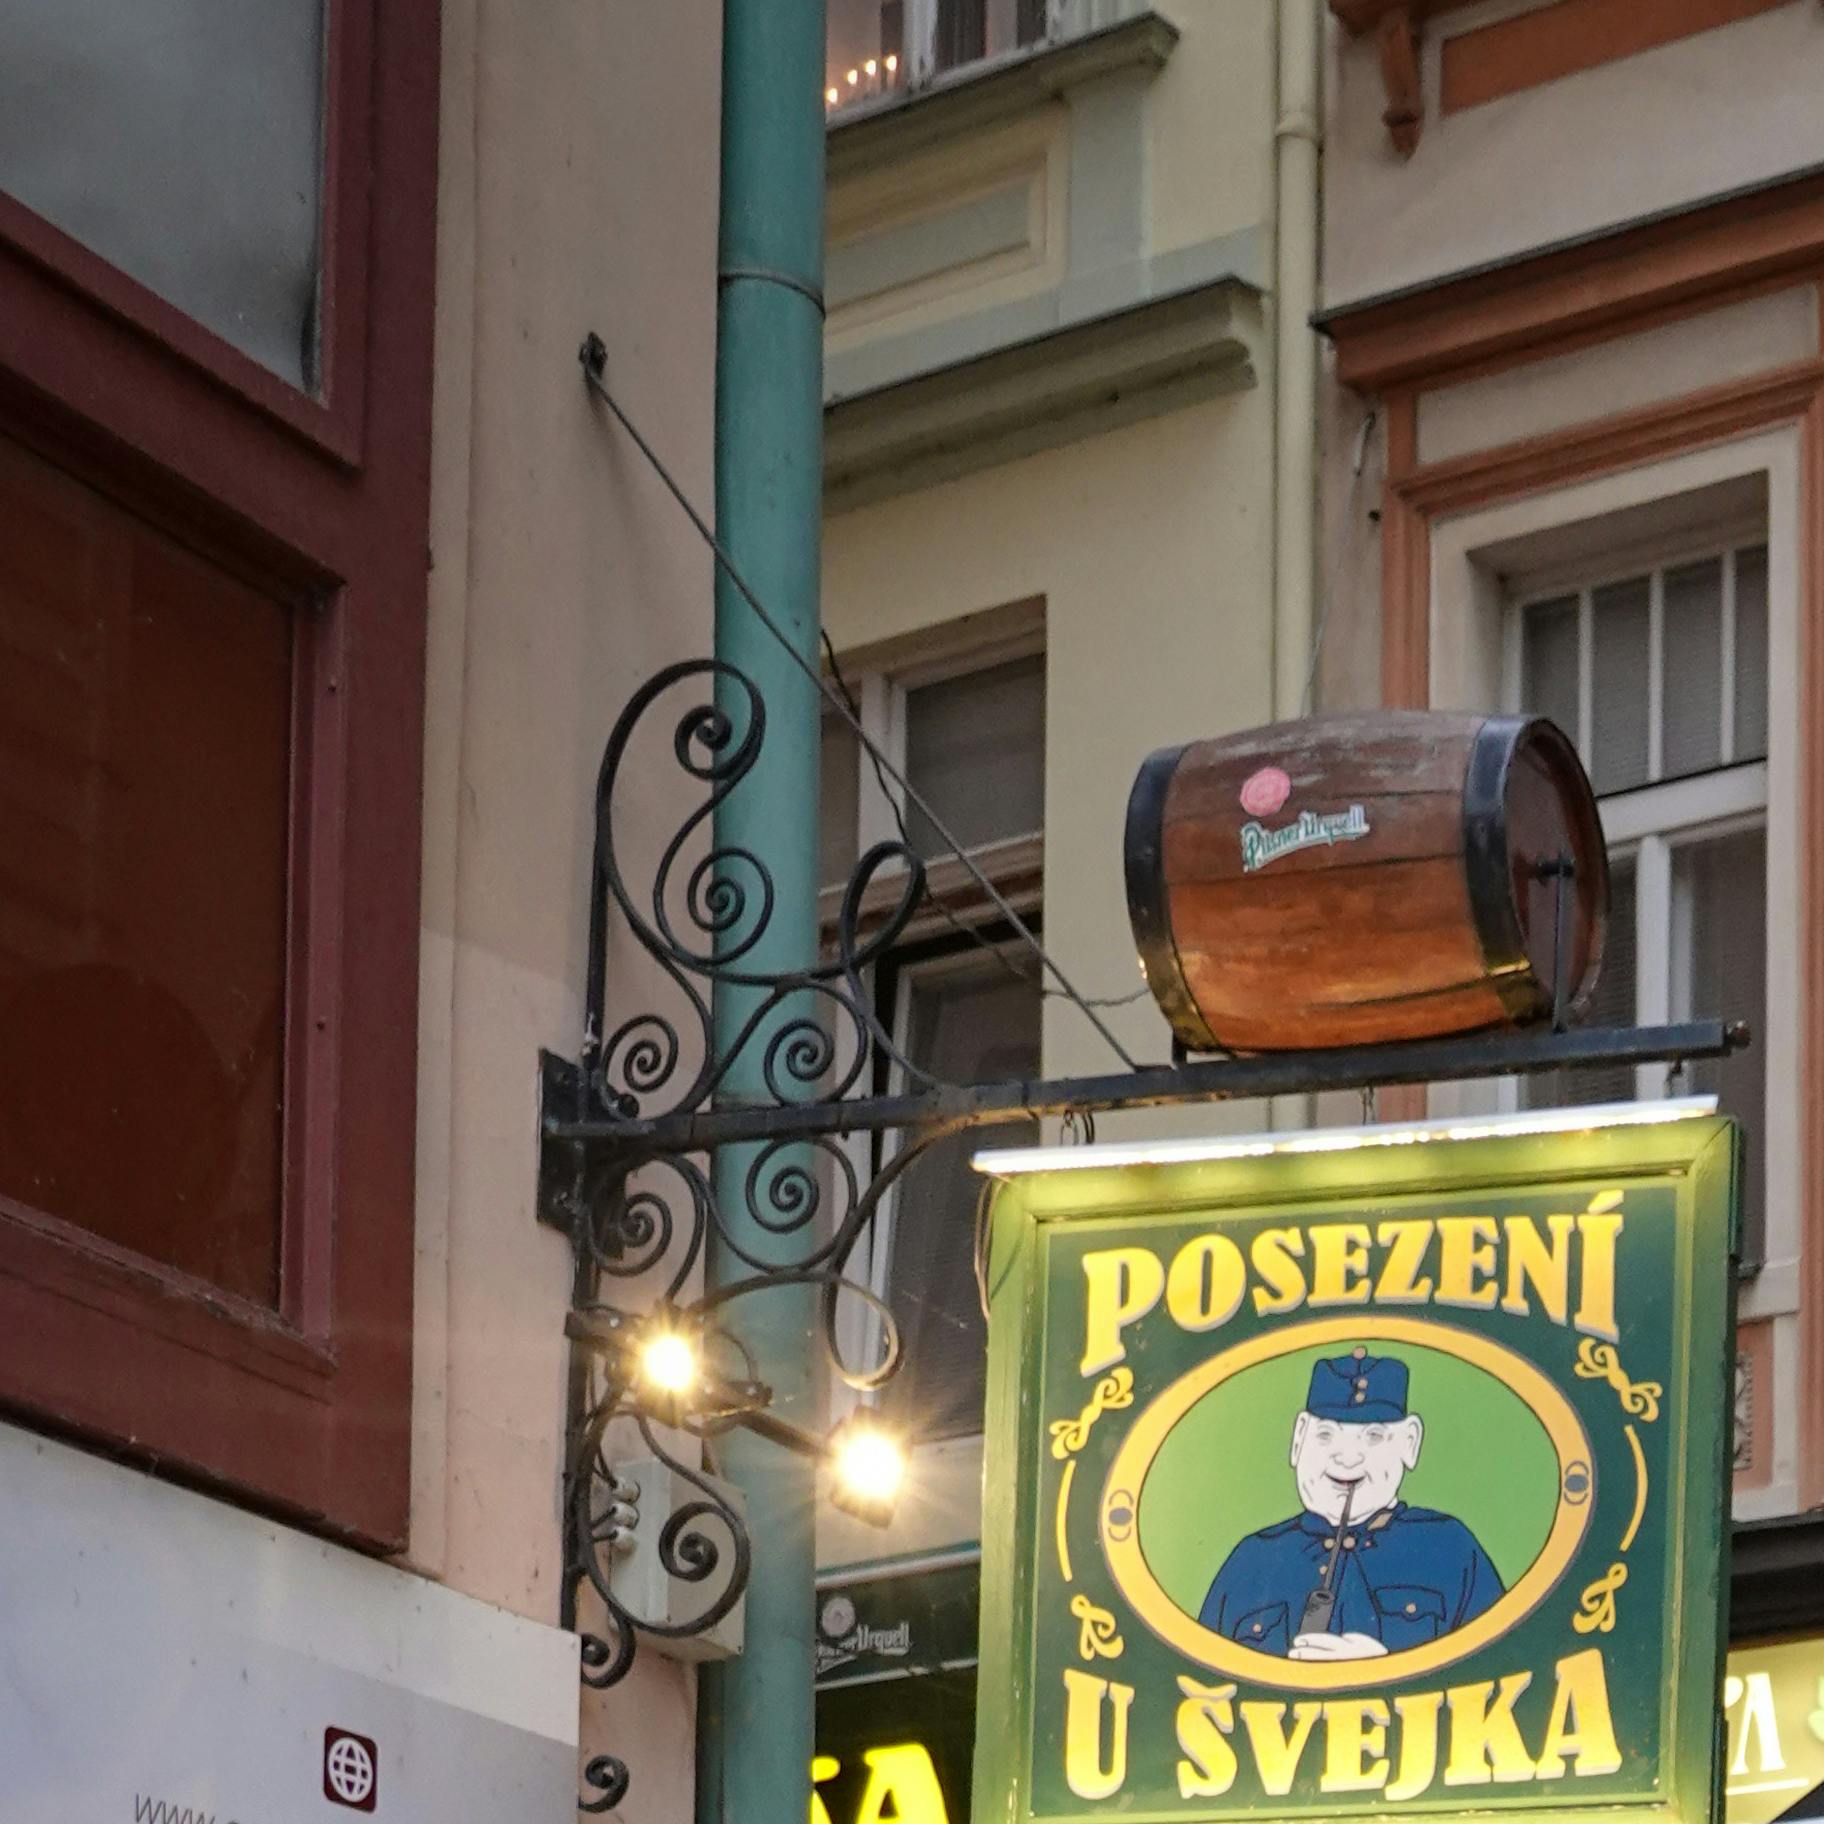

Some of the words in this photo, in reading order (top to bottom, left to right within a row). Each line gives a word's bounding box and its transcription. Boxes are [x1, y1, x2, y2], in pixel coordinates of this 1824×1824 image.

[1081, 1190, 1624, 1378] POSEZENÍ
[1063, 1669, 1135, 1800] U
[1176, 1648, 1622, 1801] ŠVEJKA
